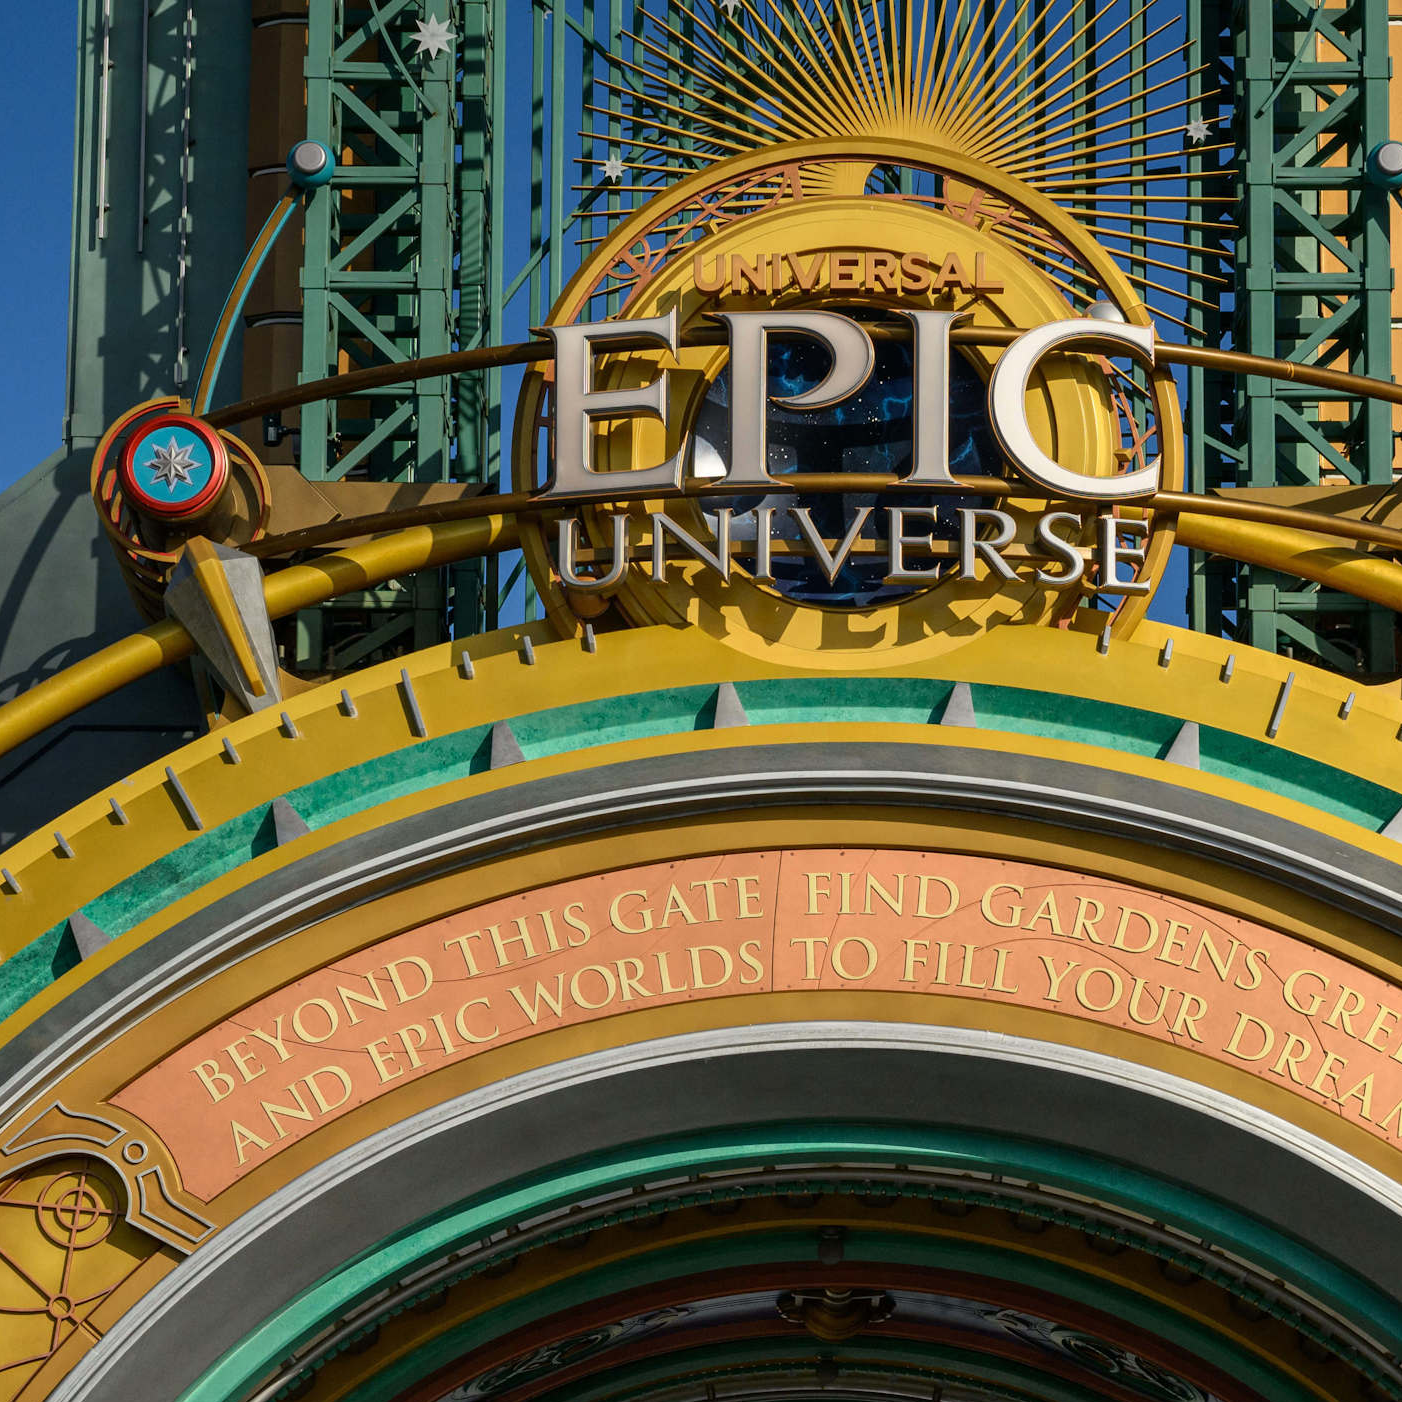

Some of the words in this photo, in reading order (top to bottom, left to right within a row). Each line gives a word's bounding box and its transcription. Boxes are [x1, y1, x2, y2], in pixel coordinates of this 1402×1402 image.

[693, 252, 1004, 297] UNIVERSAL
[529, 304, 1163, 503] EPIC
[555, 503, 1152, 596] UNIVERSE
[190, 956, 435, 1103] BEYOND
[443, 902, 592, 980] THIS
[608, 875, 765, 935] GATE
[805, 872, 960, 920] FIND
[980, 883, 1272, 992] GARDENS
[230, 1064, 353, 1167] AND
[367, 997, 500, 1086] EPIC
[507, 939, 766, 1027] WORLDS
[791, 936, 879, 982] TO
[900, 939, 1019, 996] FILL
[1037, 954, 1208, 1045] YOUR
